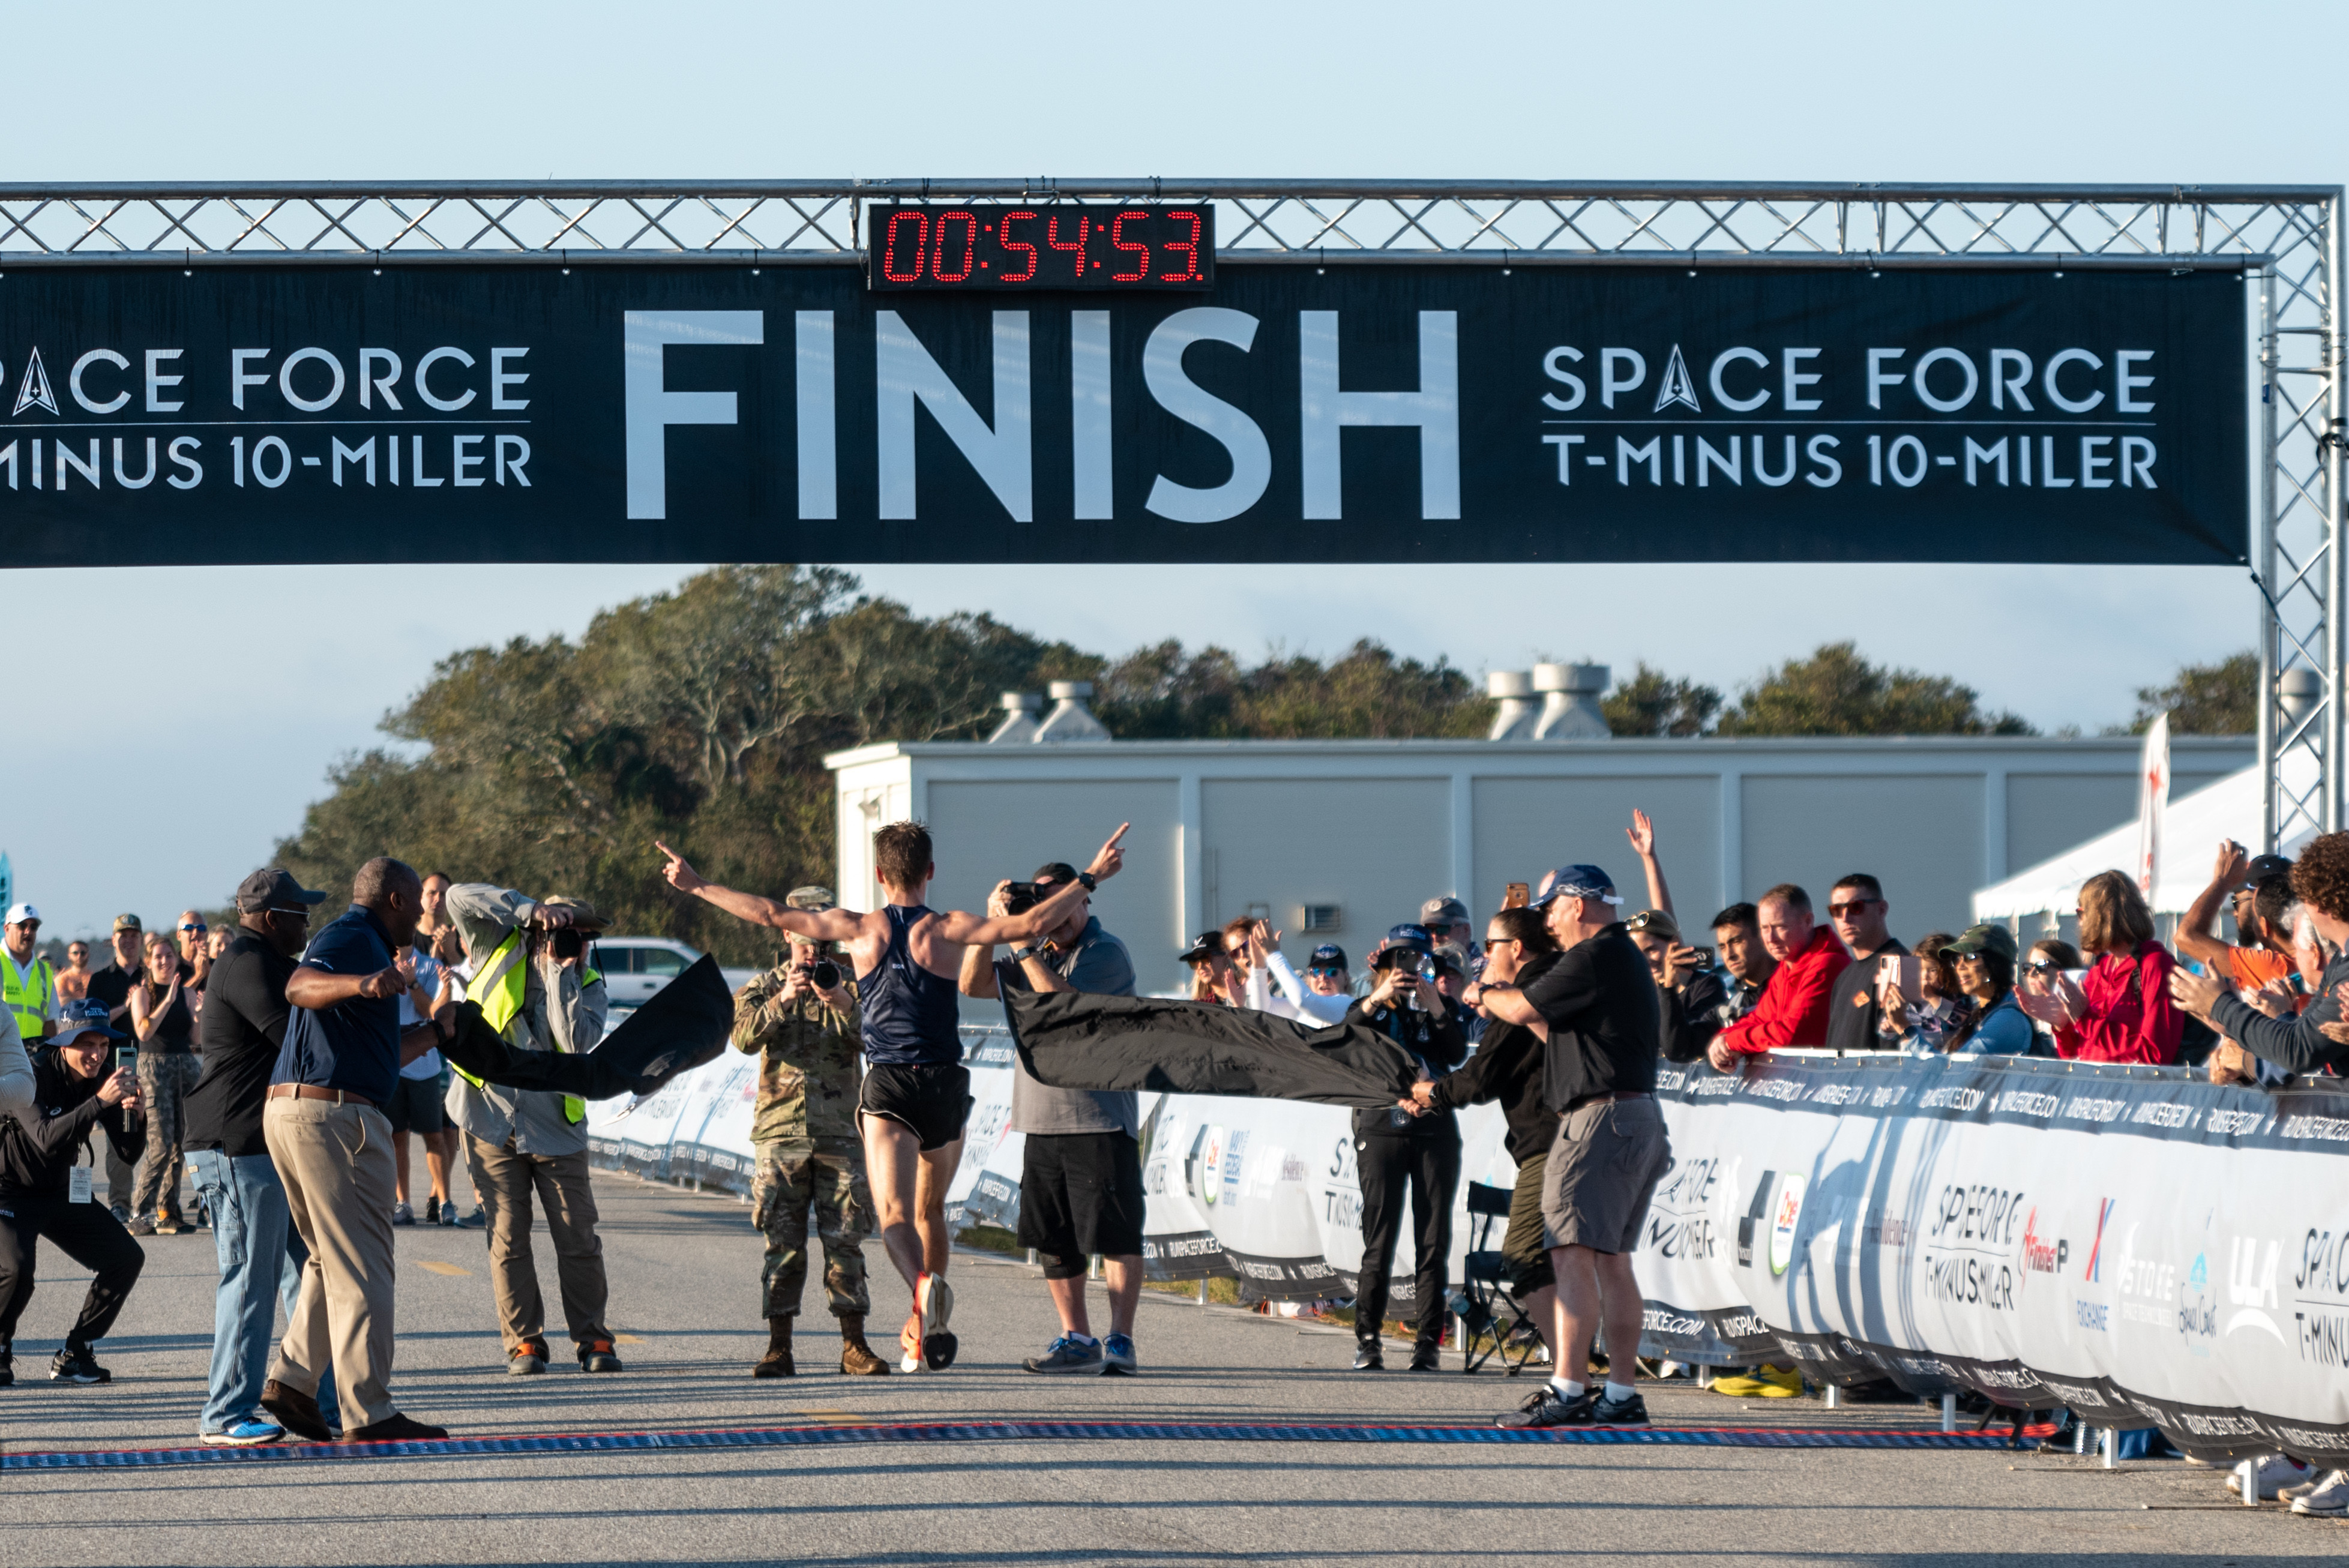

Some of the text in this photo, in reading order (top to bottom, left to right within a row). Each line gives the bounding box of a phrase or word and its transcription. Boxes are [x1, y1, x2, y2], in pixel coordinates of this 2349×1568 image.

[0, 346, 531, 416] ACE FORCE
[1541, 344, 2156, 413] SPACE FORCE
[624, 307, 1461, 523] FINISH
[230, 435, 532, 487] 10-MILER
[1542, 434, 2158, 488] T-MINUS 10-MILER
